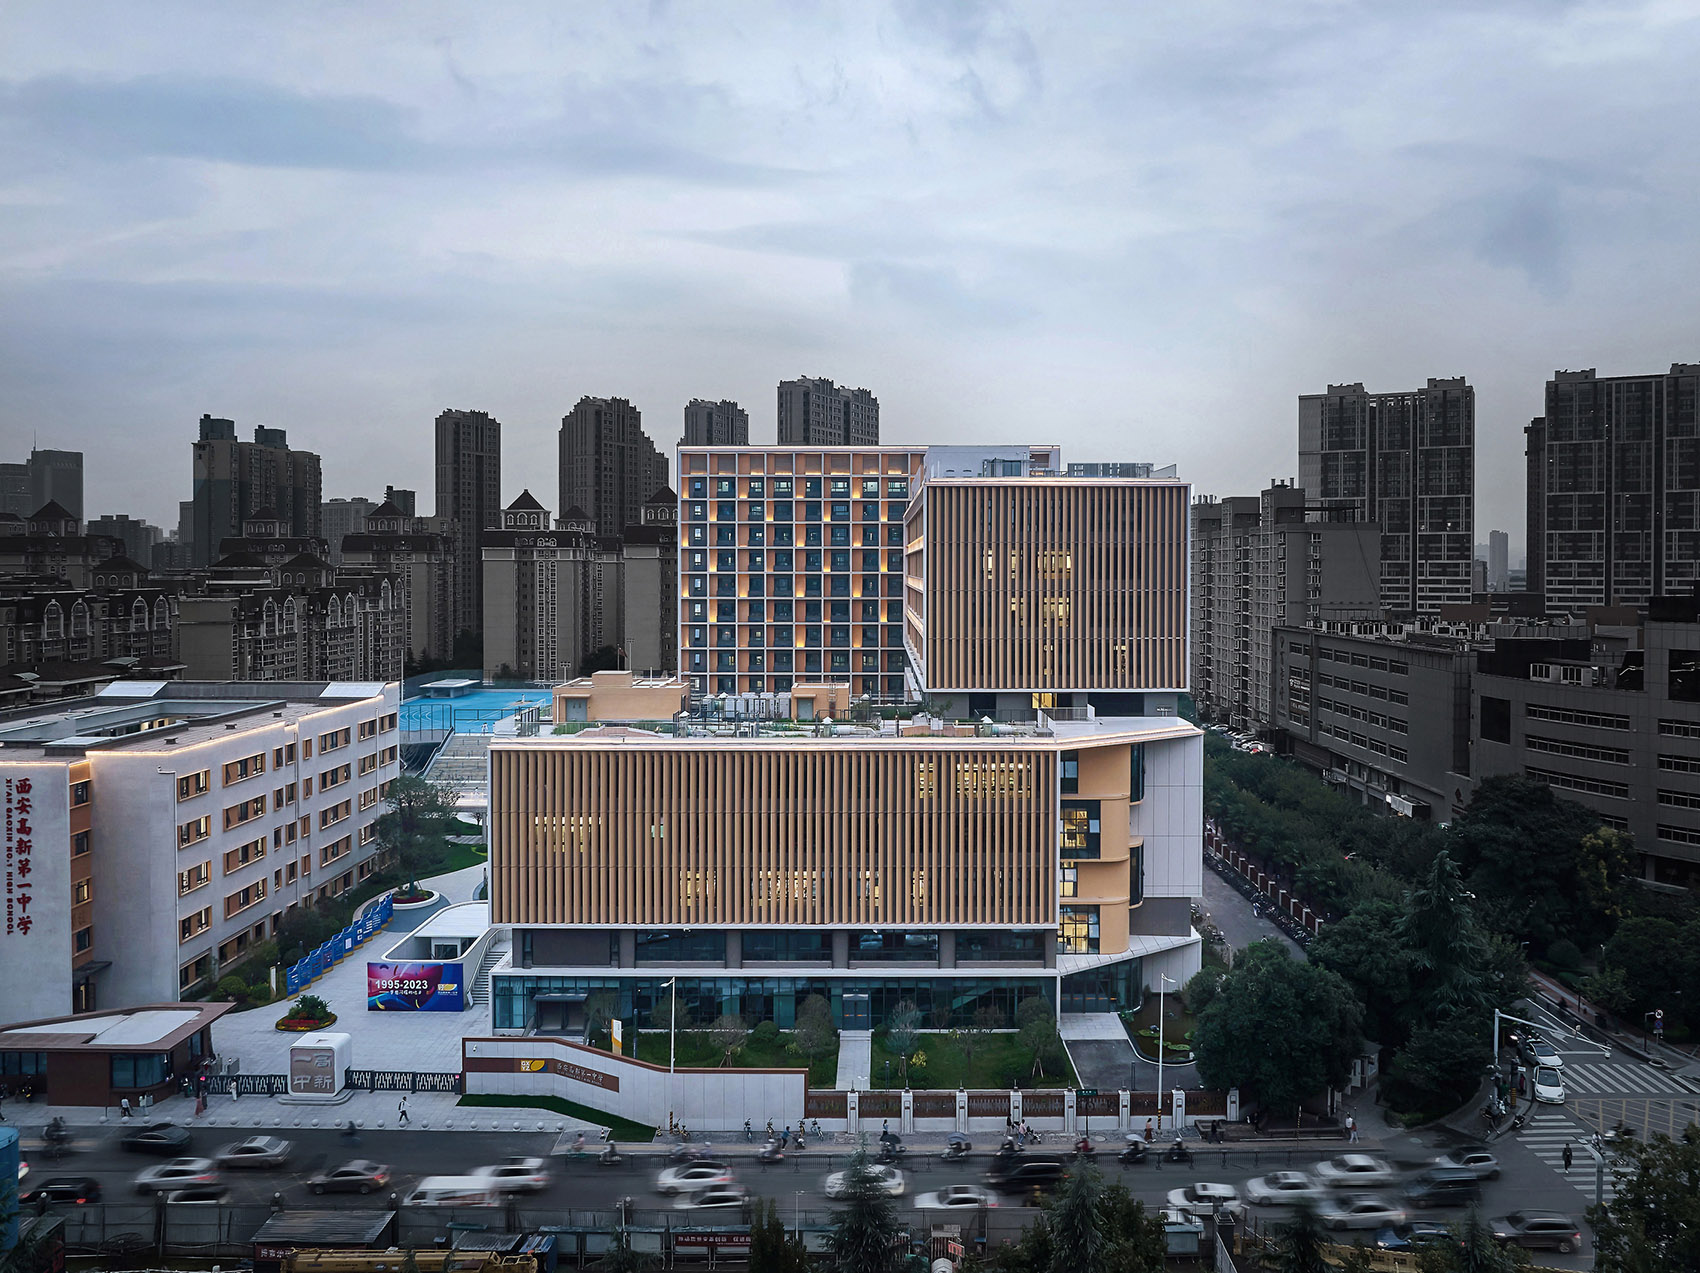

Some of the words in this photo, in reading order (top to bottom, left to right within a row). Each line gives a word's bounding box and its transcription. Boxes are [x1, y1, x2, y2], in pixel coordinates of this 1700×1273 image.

[5, 778, 13, 804] XI'AN
[14, 777, 33, 936] 西安高新第一中学
[375, 980, 428, 989] 1995-2023
